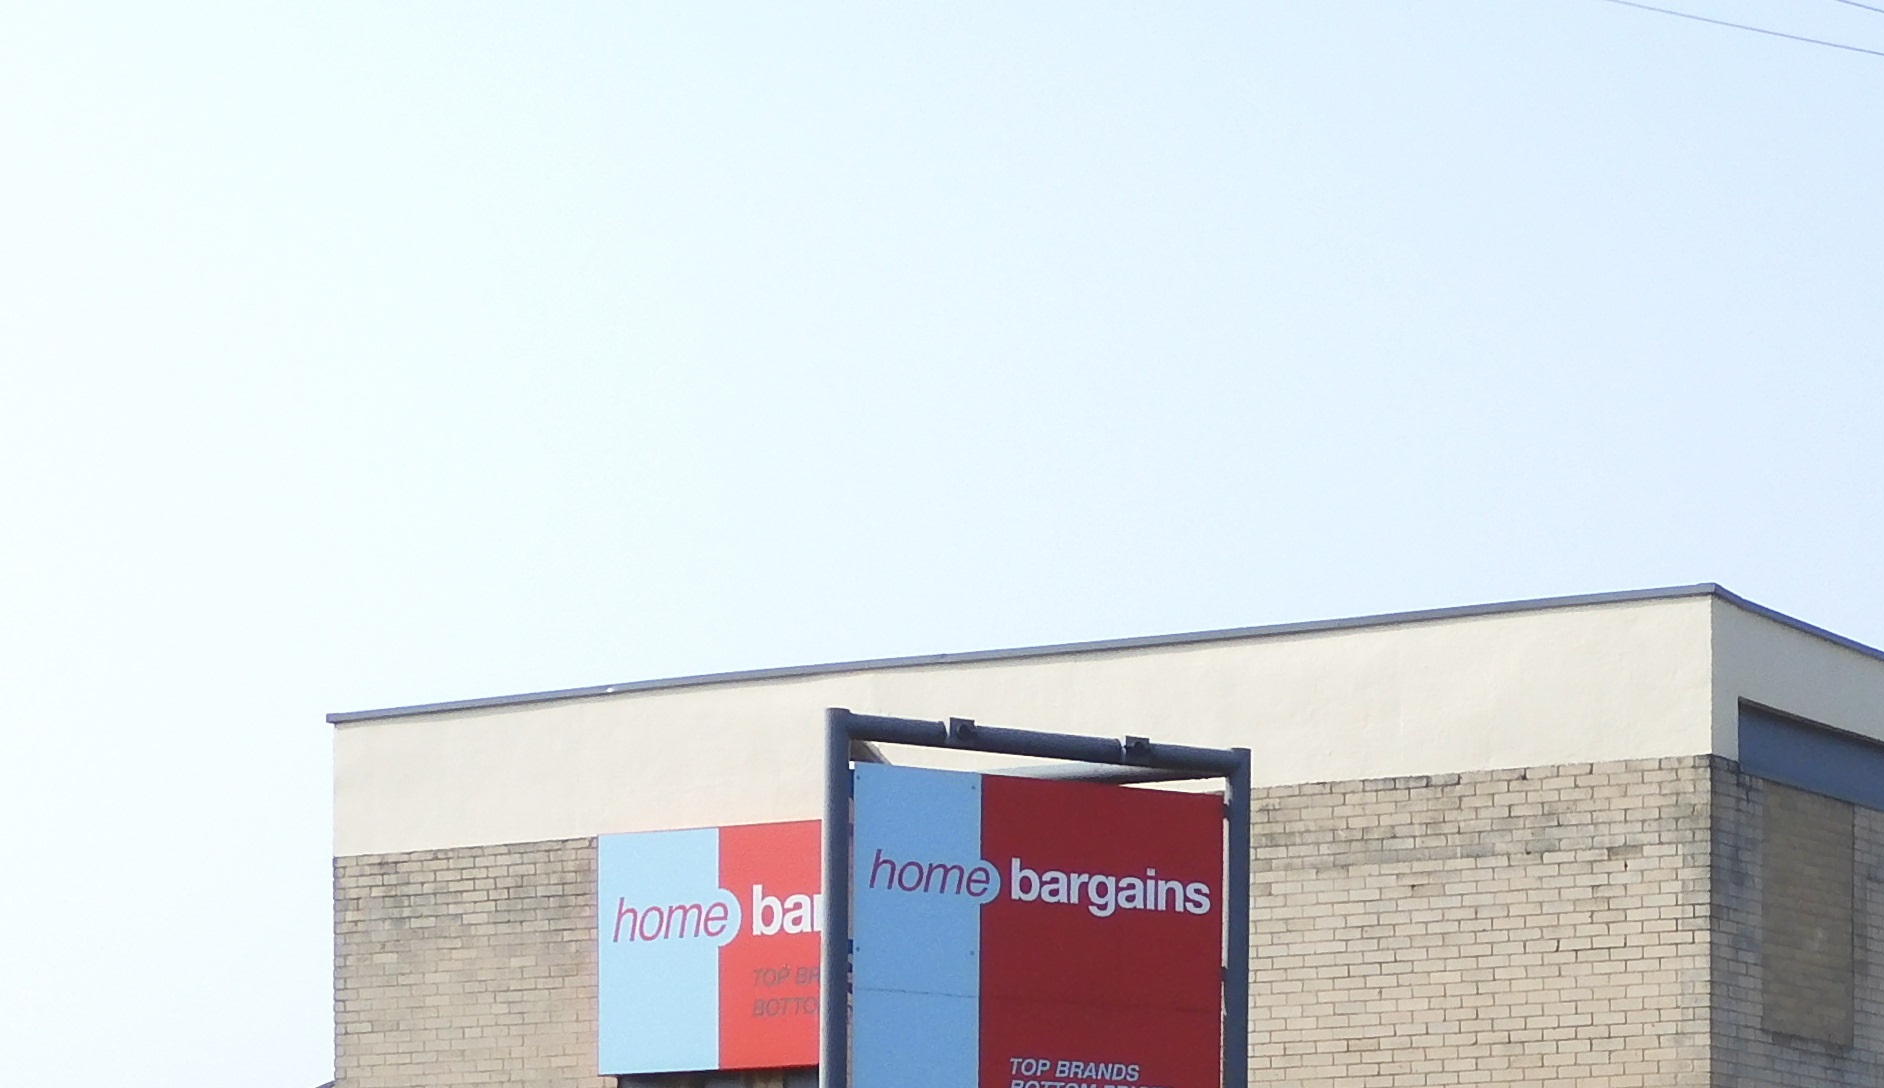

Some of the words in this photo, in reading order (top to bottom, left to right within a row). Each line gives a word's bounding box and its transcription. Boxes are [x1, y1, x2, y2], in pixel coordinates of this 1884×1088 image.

[869, 849, 991, 897] home
[1010, 857, 1211, 917] bargains
[612, 896, 729, 943] home
[753, 967, 791, 987] TOP
[1009, 1057, 1051, 1076] TOP
[1055, 1060, 1140, 1082] BRANDS
